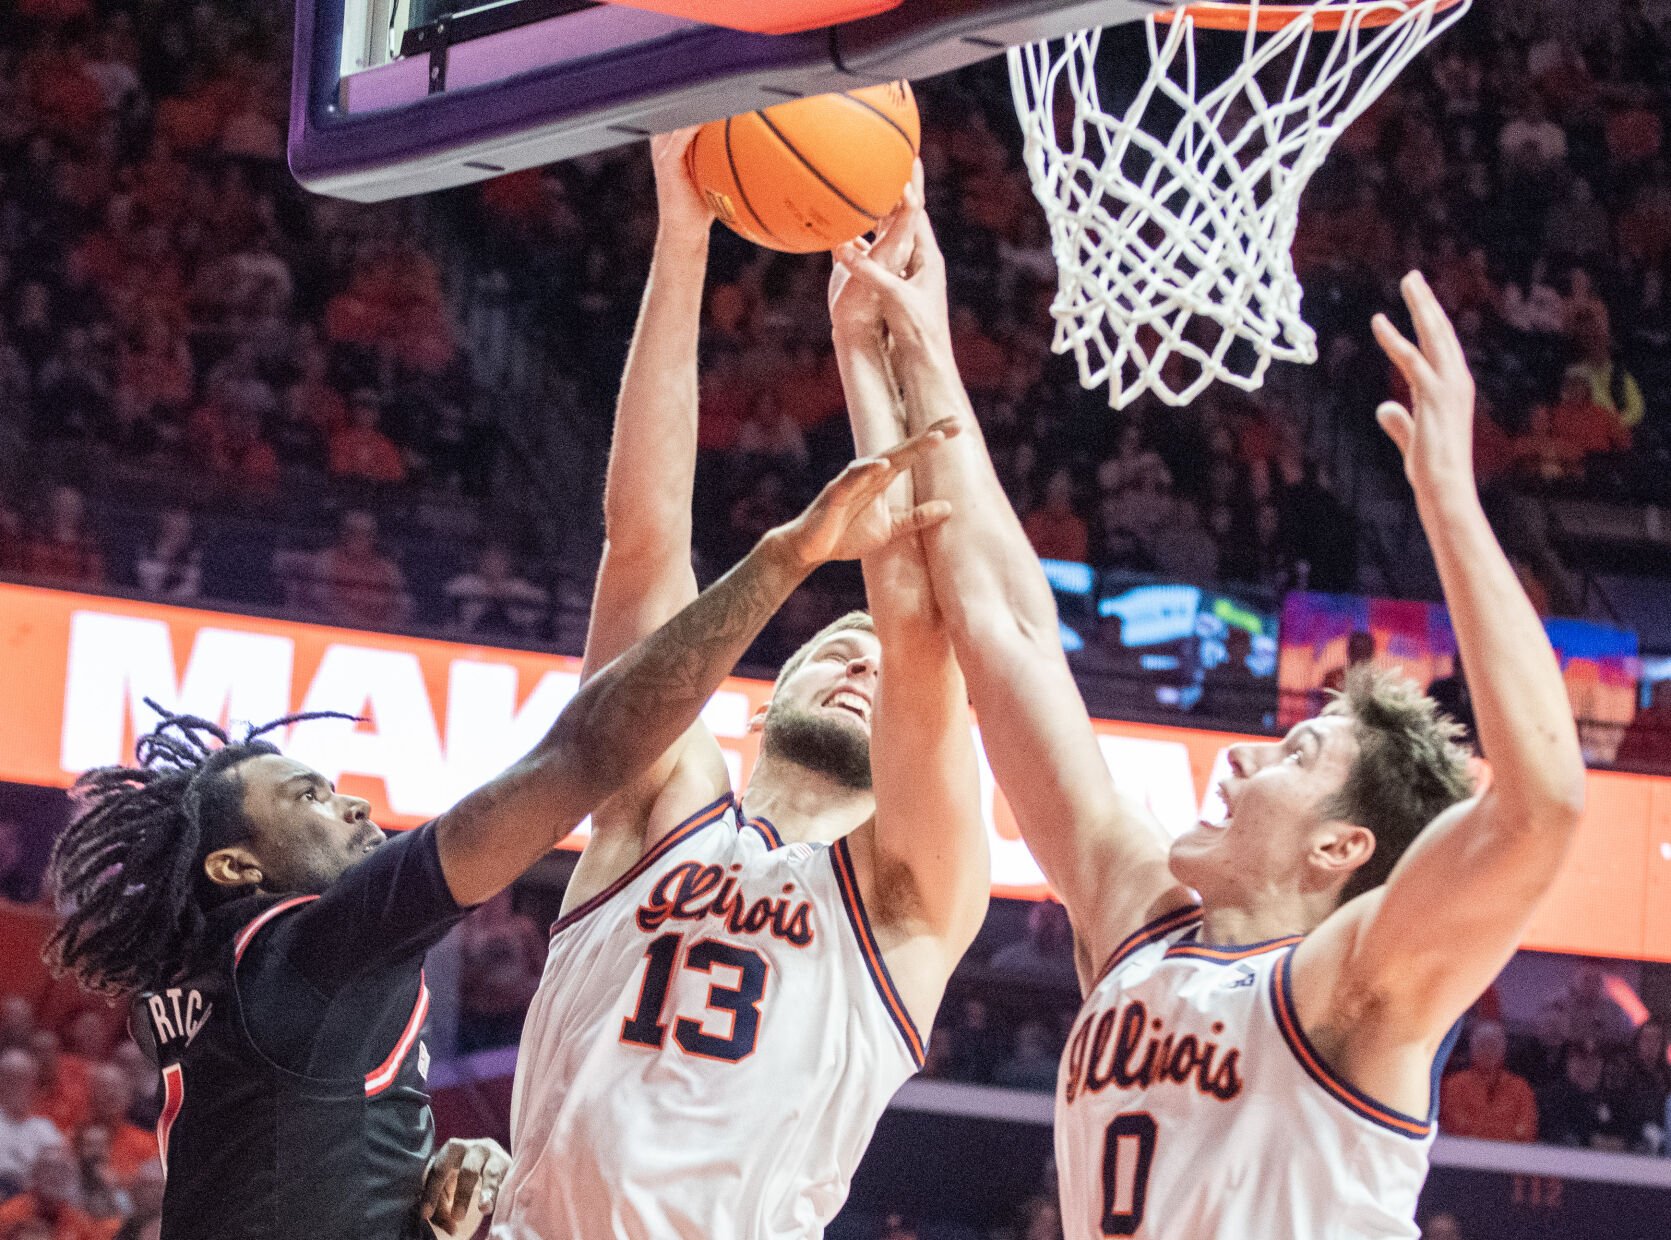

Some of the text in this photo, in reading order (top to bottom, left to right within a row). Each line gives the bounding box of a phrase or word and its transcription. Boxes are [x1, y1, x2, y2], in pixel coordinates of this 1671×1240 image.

[60, 609, 750, 838] MAK
[619, 931, 770, 1064] 13
[1099, 1111, 1158, 1238] 0
